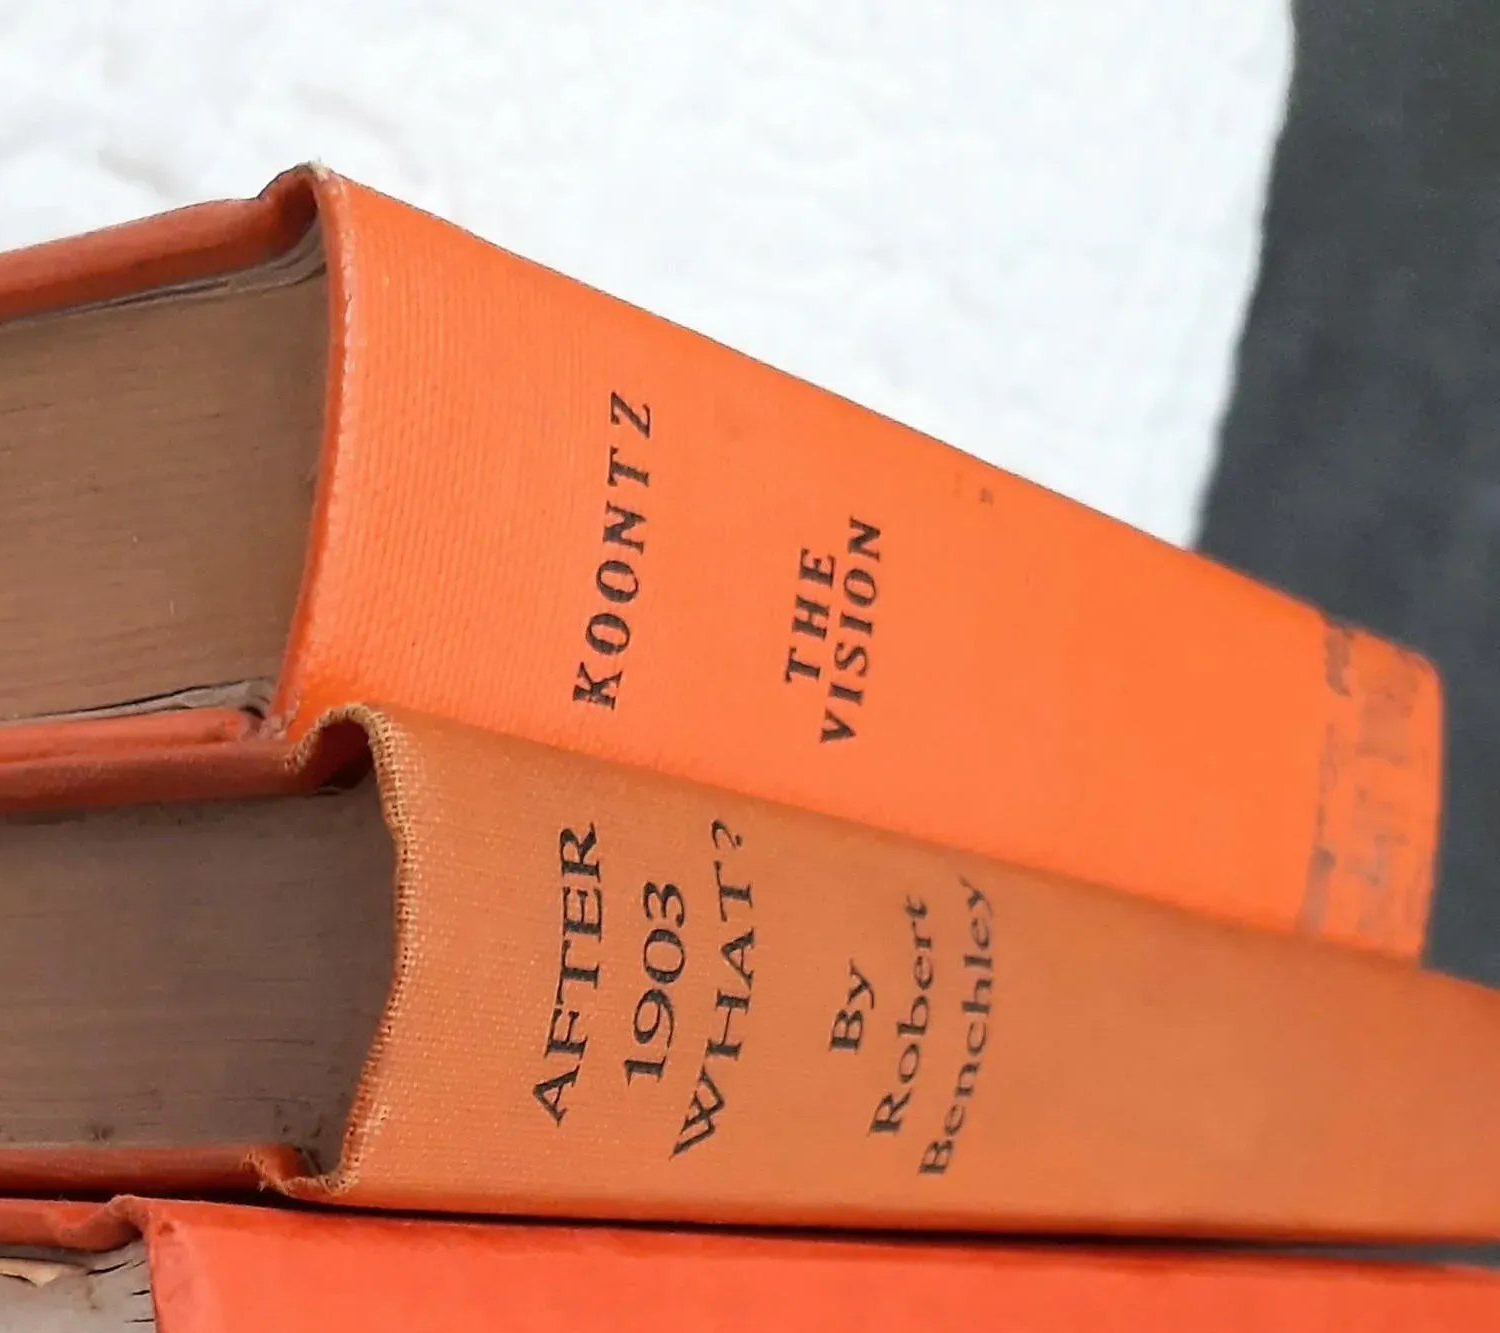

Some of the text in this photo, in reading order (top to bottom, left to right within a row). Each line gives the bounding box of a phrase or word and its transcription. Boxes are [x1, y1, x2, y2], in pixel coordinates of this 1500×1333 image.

[572, 391, 651, 711] KOONTZ
[784, 547, 836, 684] THE
[820, 516, 881, 744] VISION
[532, 823, 602, 1128] AFTER
[623, 881, 685, 1086] 1903
[669, 819, 756, 1161] WHAT?
[829, 959, 875, 1053] By
[868, 895, 934, 1138] Robert
[917, 875, 994, 1177] Benchley
